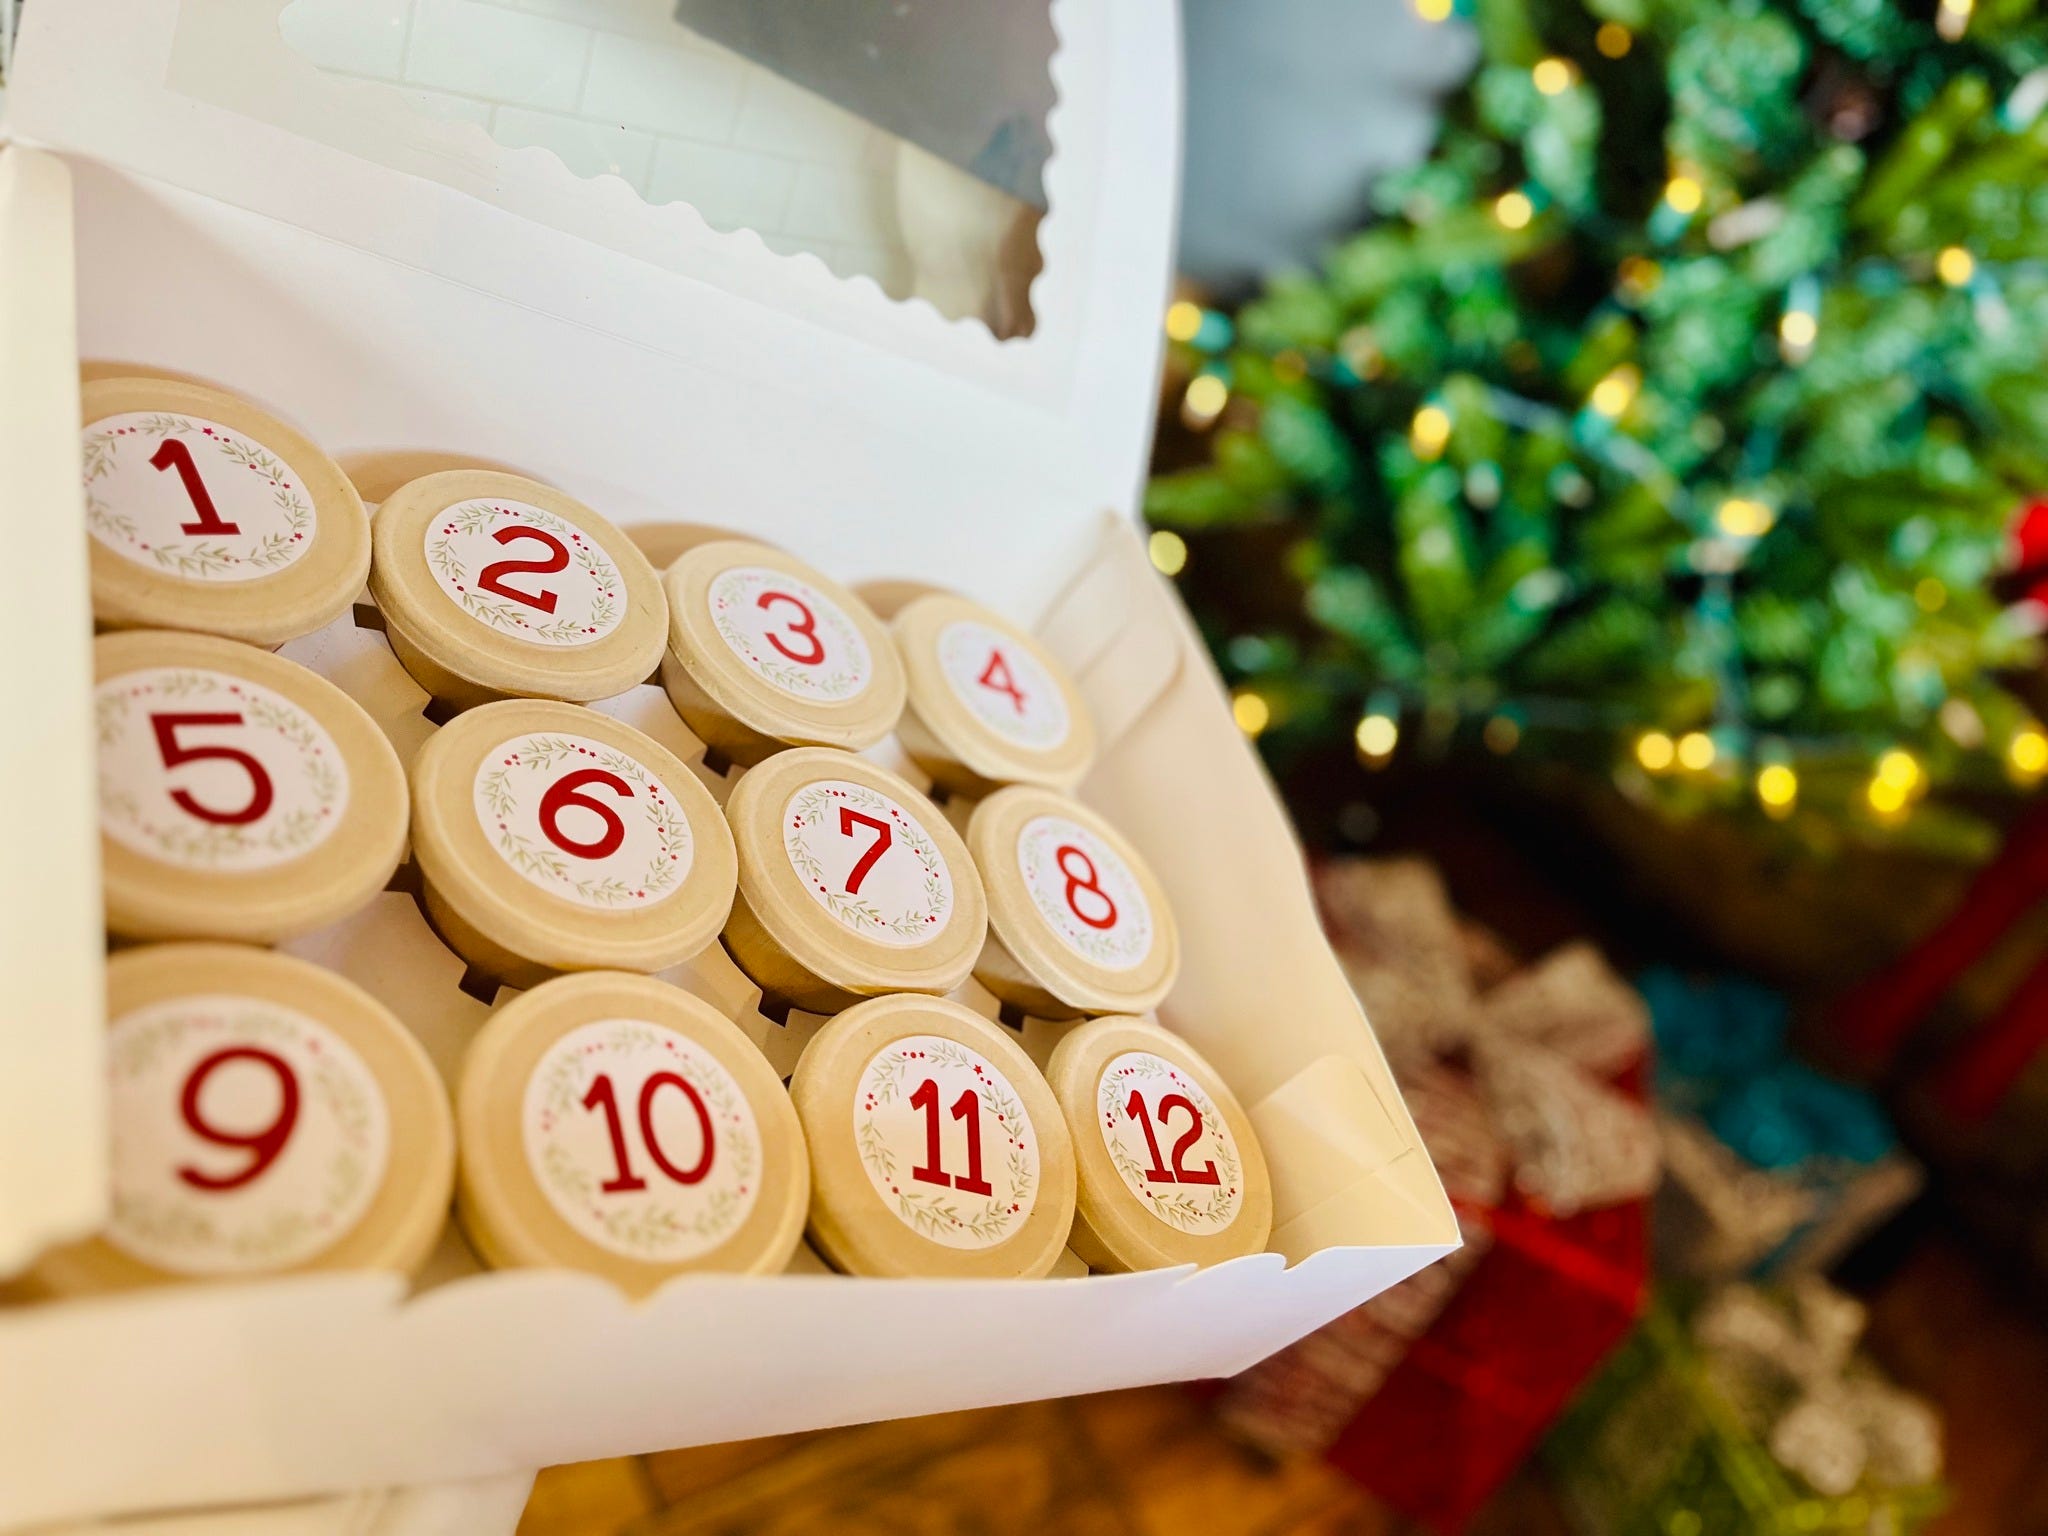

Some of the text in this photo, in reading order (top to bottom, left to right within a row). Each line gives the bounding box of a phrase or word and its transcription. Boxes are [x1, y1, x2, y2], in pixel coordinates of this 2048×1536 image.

[149, 438, 240, 536] 1
[477, 525, 570, 615] 2
[756, 591, 826, 666] 3
[977, 648, 1029, 713] 4
[149, 712, 274, 827] 5
[538, 768, 635, 860] 6
[839, 806, 892, 895] 7
[1056, 845, 1118, 930] 8
[176, 1045, 302, 1194] 9
[581, 1070, 716, 1195] 10
[909, 1078, 993, 1197] 11
[1125, 1089, 1221, 1186] 12
